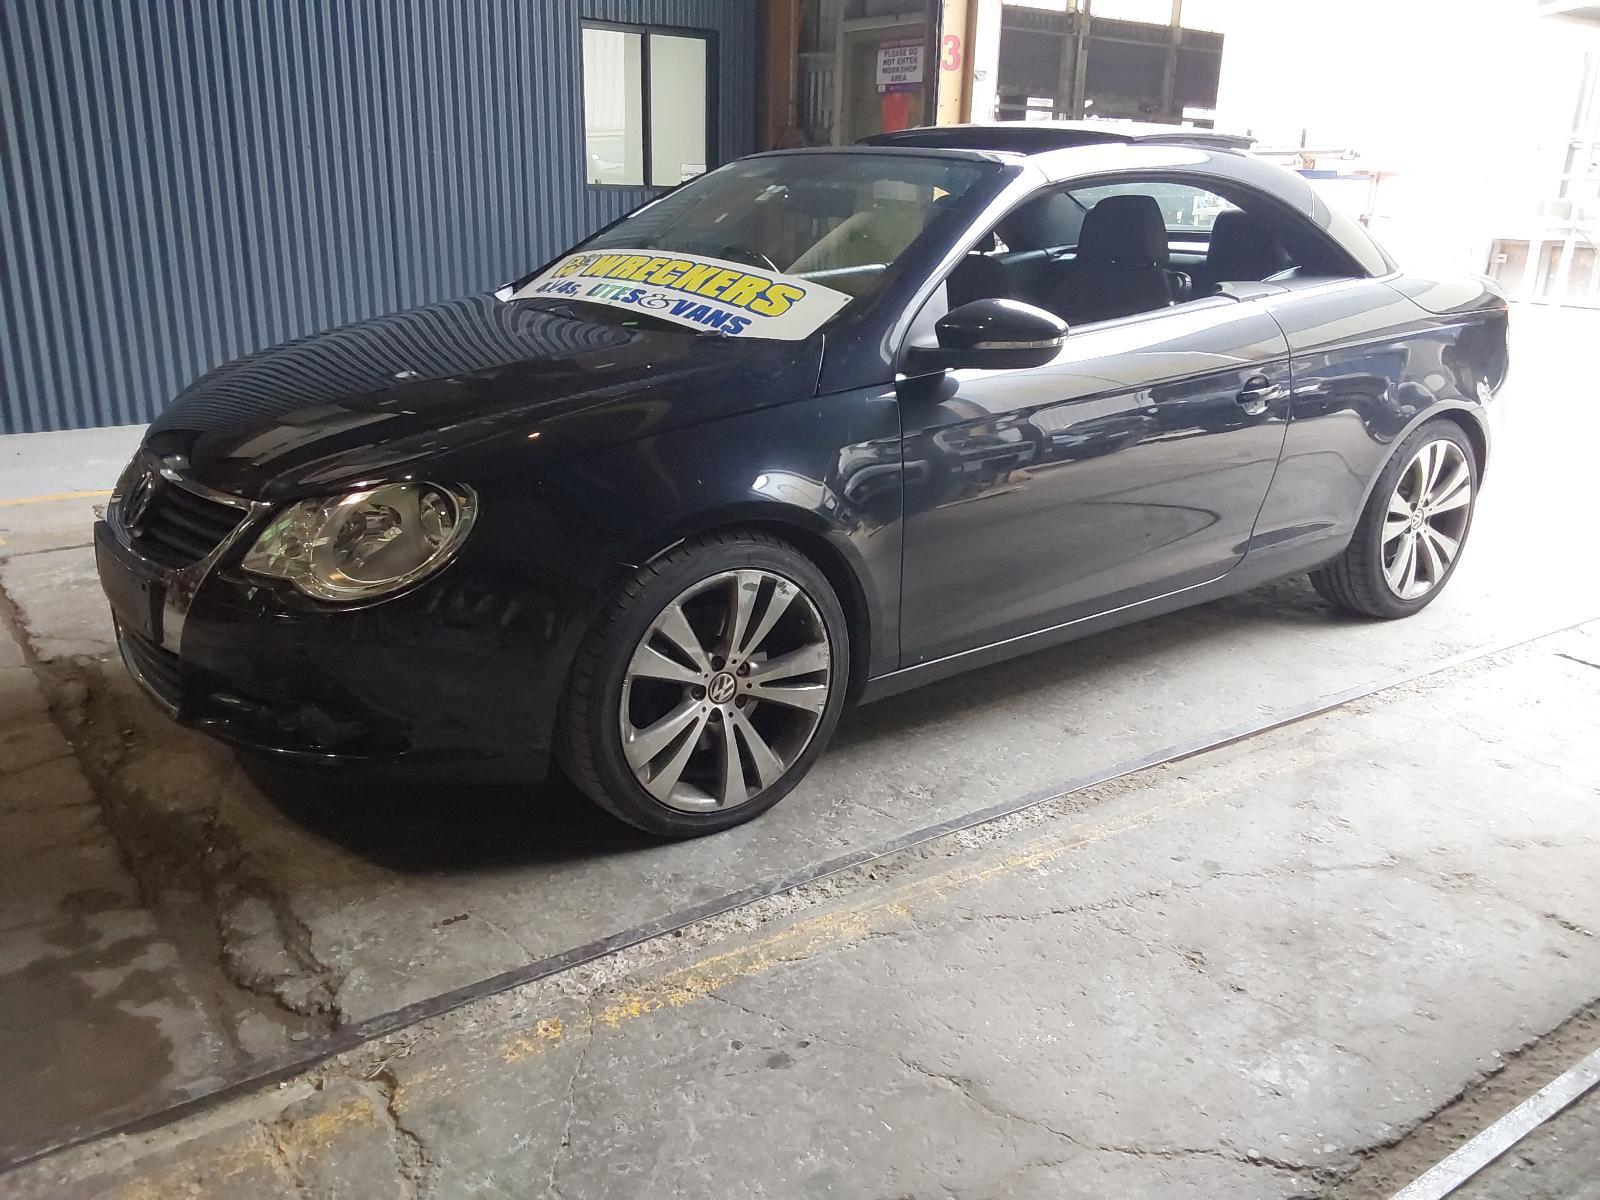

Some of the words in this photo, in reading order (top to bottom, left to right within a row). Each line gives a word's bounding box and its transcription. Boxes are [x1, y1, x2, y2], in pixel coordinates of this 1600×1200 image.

[884, 49, 907, 57] PLEASE
[942, 35, 960, 71] 3
[882, 58, 895, 66] NOT
[897, 57, 918, 65] ENTER
[882, 65, 918, 74] WORKSHOP
[890, 74, 907, 82] AREA
[578, 253, 807, 317] WRECKERS
[585, 283, 647, 303] UTES
[638, 293, 678, 310] &
[669, 299, 753, 335] VANS
